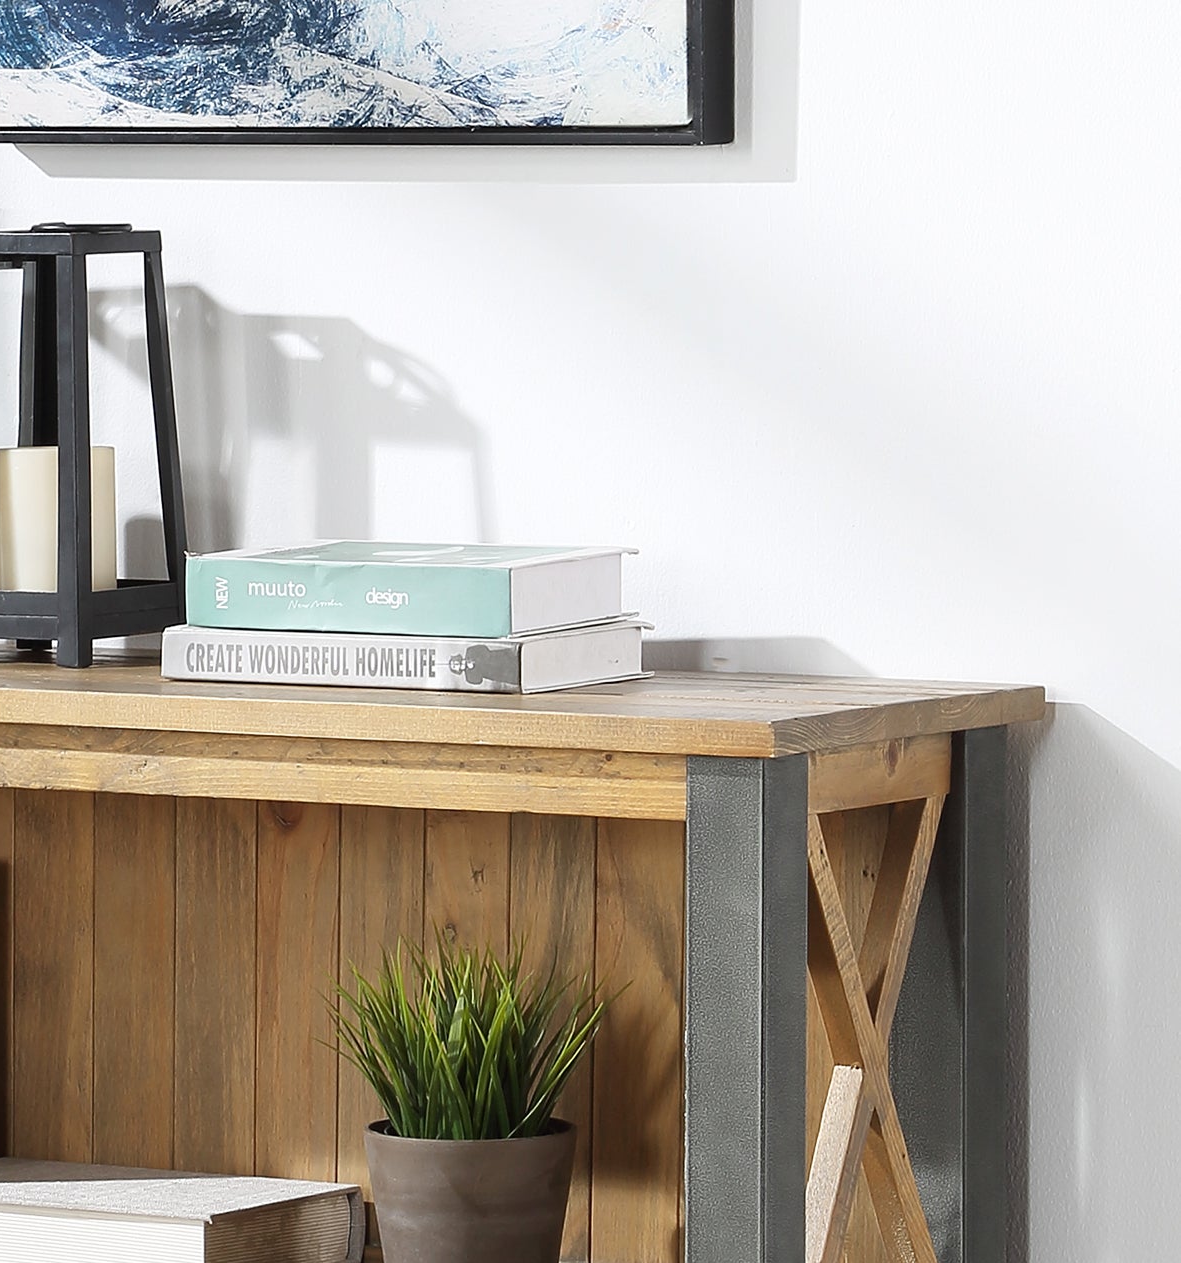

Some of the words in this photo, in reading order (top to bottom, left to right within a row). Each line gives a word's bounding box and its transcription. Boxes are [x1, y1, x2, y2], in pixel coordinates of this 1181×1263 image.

[216, 576, 229, 609] NEW
[248, 580, 307, 598] muuto
[365, 587, 409, 609] design
[186, 642, 243, 674] CREATE
[249, 644, 349, 676] WONDERFUL
[356, 647, 437, 679] HOMELIFE
